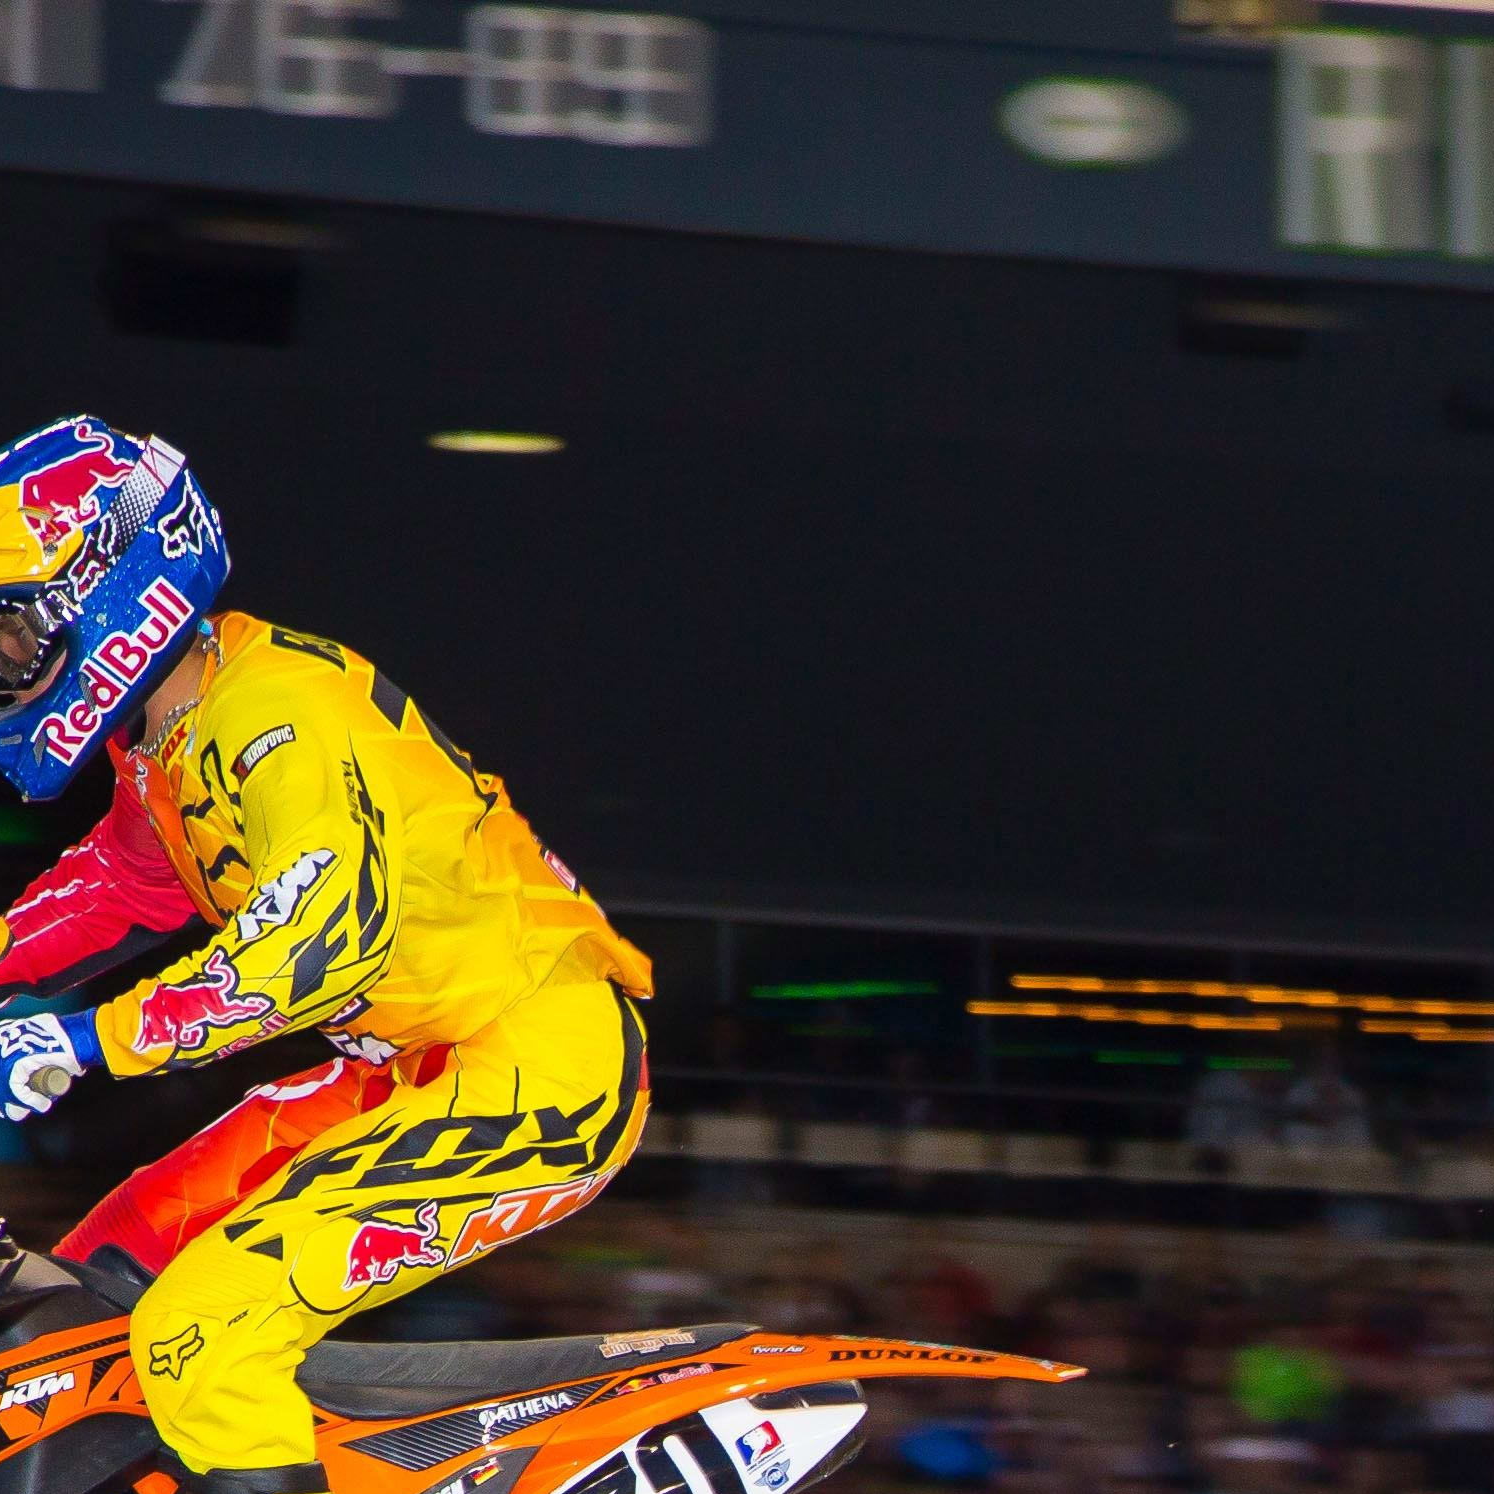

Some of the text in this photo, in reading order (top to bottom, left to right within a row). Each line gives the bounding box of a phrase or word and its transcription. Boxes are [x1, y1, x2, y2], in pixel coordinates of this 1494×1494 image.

[44, 580, 192, 763] Red Bull
[237, 849, 335, 940] KTM
[828, 1349, 998, 1363] DUNLOP
[0, 1371, 75, 1411] KTM
[497, 1392, 573, 1424] ATHENA
